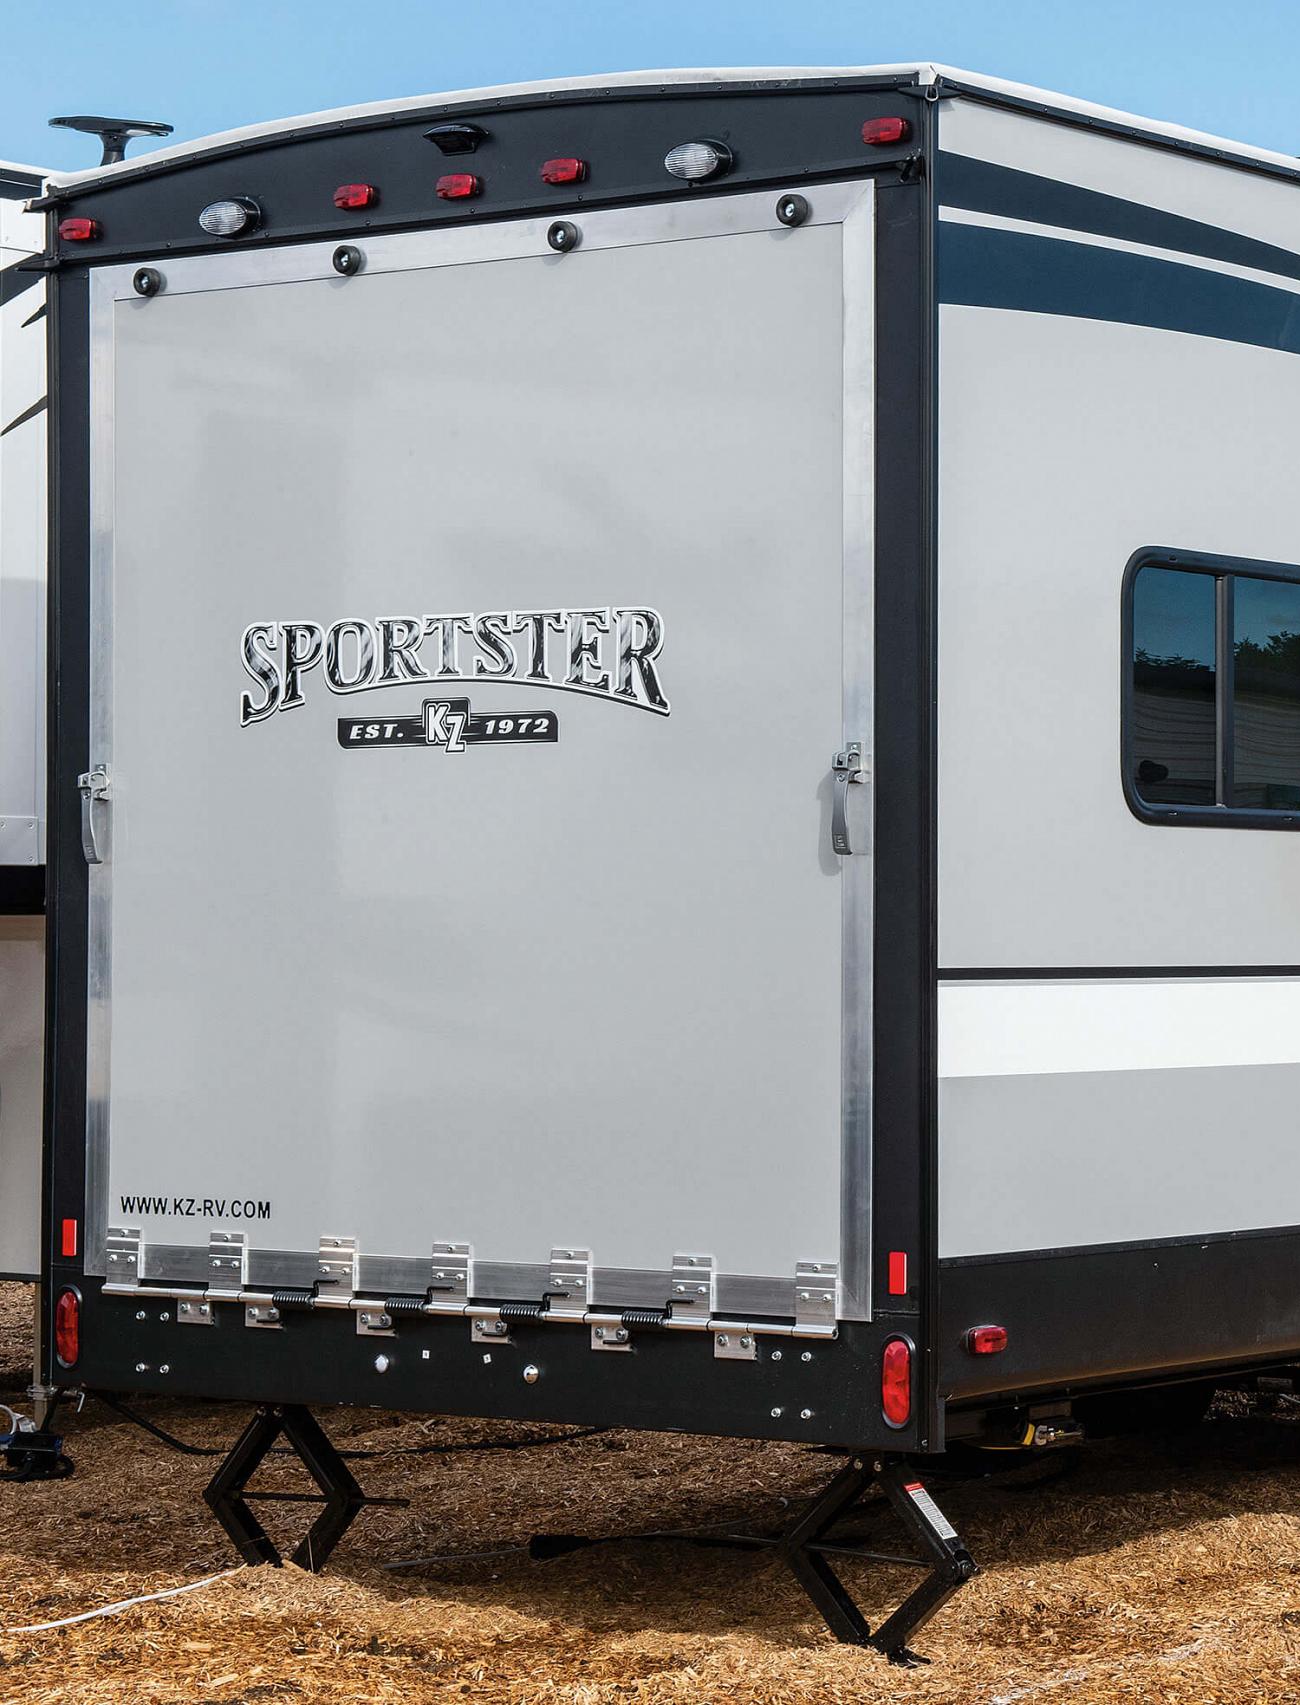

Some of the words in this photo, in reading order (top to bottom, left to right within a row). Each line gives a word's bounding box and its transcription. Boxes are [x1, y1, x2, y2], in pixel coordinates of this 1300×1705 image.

[240, 607, 671, 728] SPORTSTER
[349, 723, 404, 740] EST.
[424, 702, 468, 753] KZ
[484, 717, 551, 735] 1972
[120, 1195, 271, 1220] WWW.KZ-RV.COM
